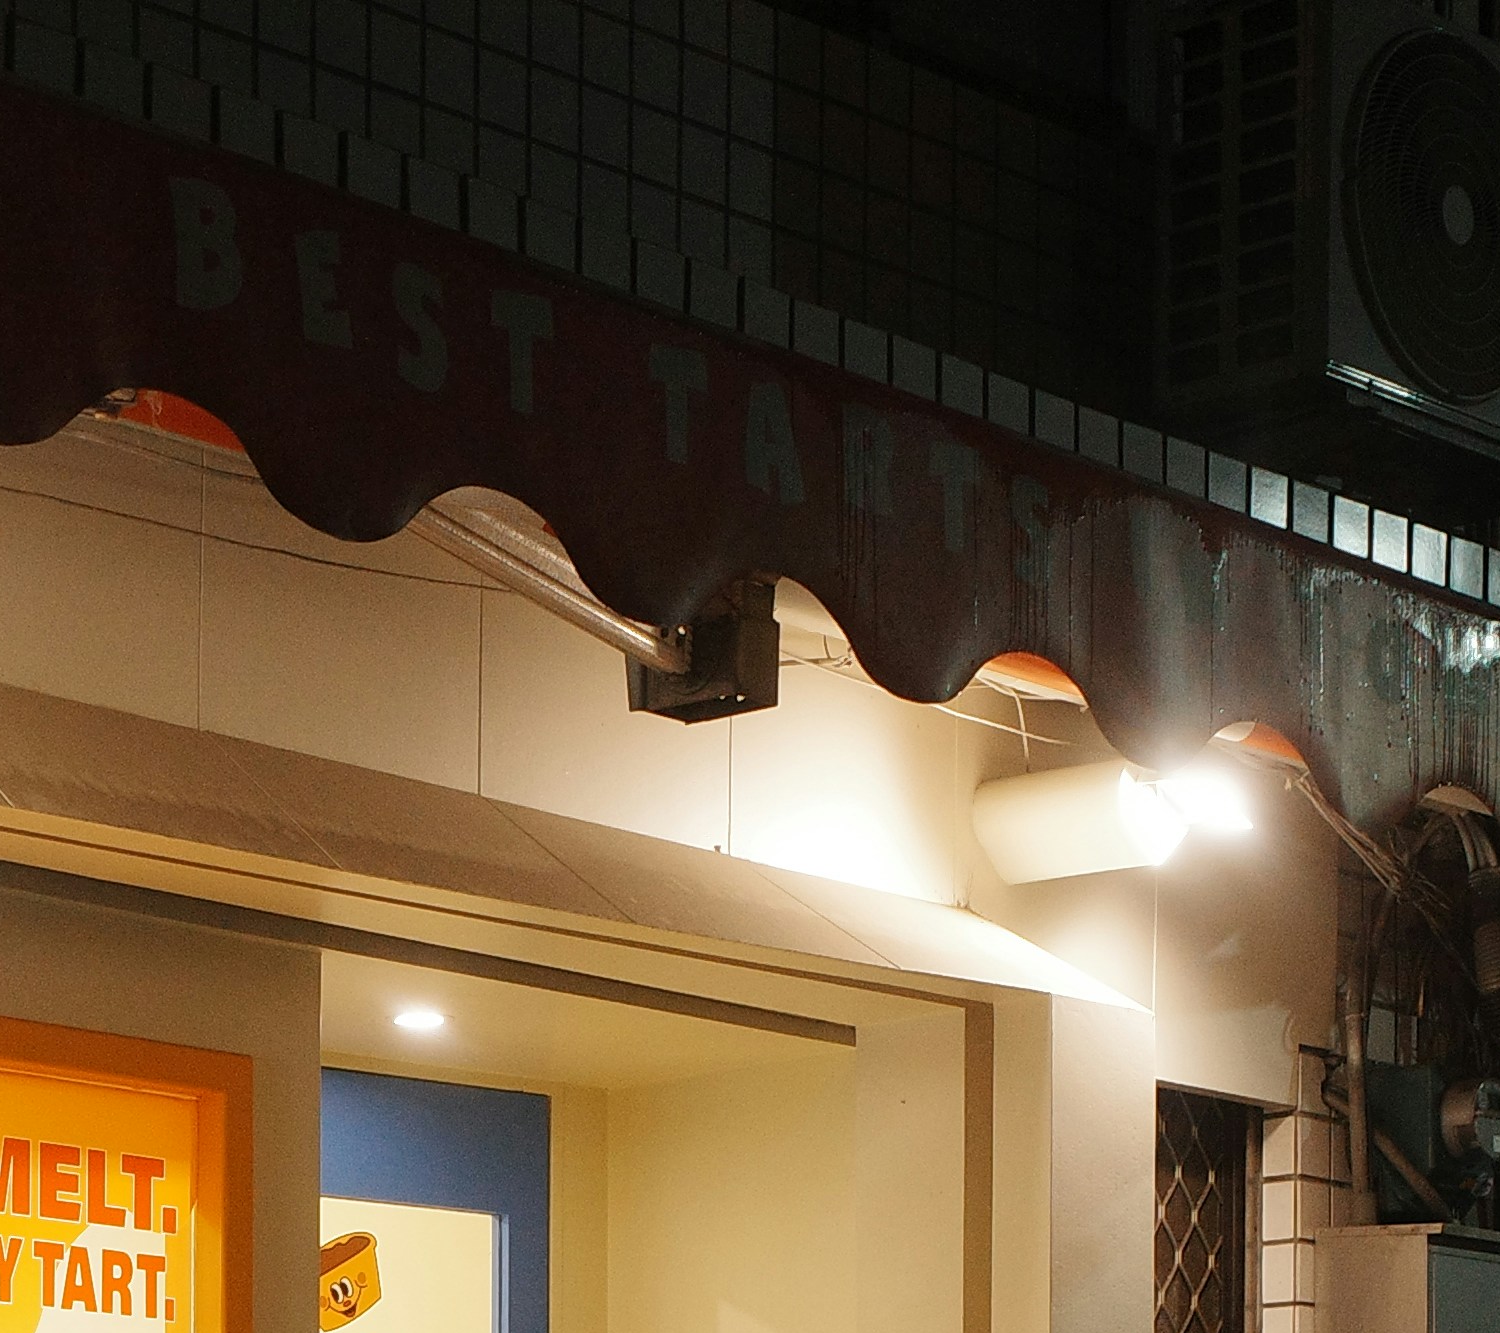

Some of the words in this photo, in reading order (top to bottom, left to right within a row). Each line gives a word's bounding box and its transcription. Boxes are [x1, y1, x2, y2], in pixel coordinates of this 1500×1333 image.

[169, 176, 554, 412] BEST
[650, 344, 1052, 586] TARTS
[38, 1243, 177, 1322] TART.
